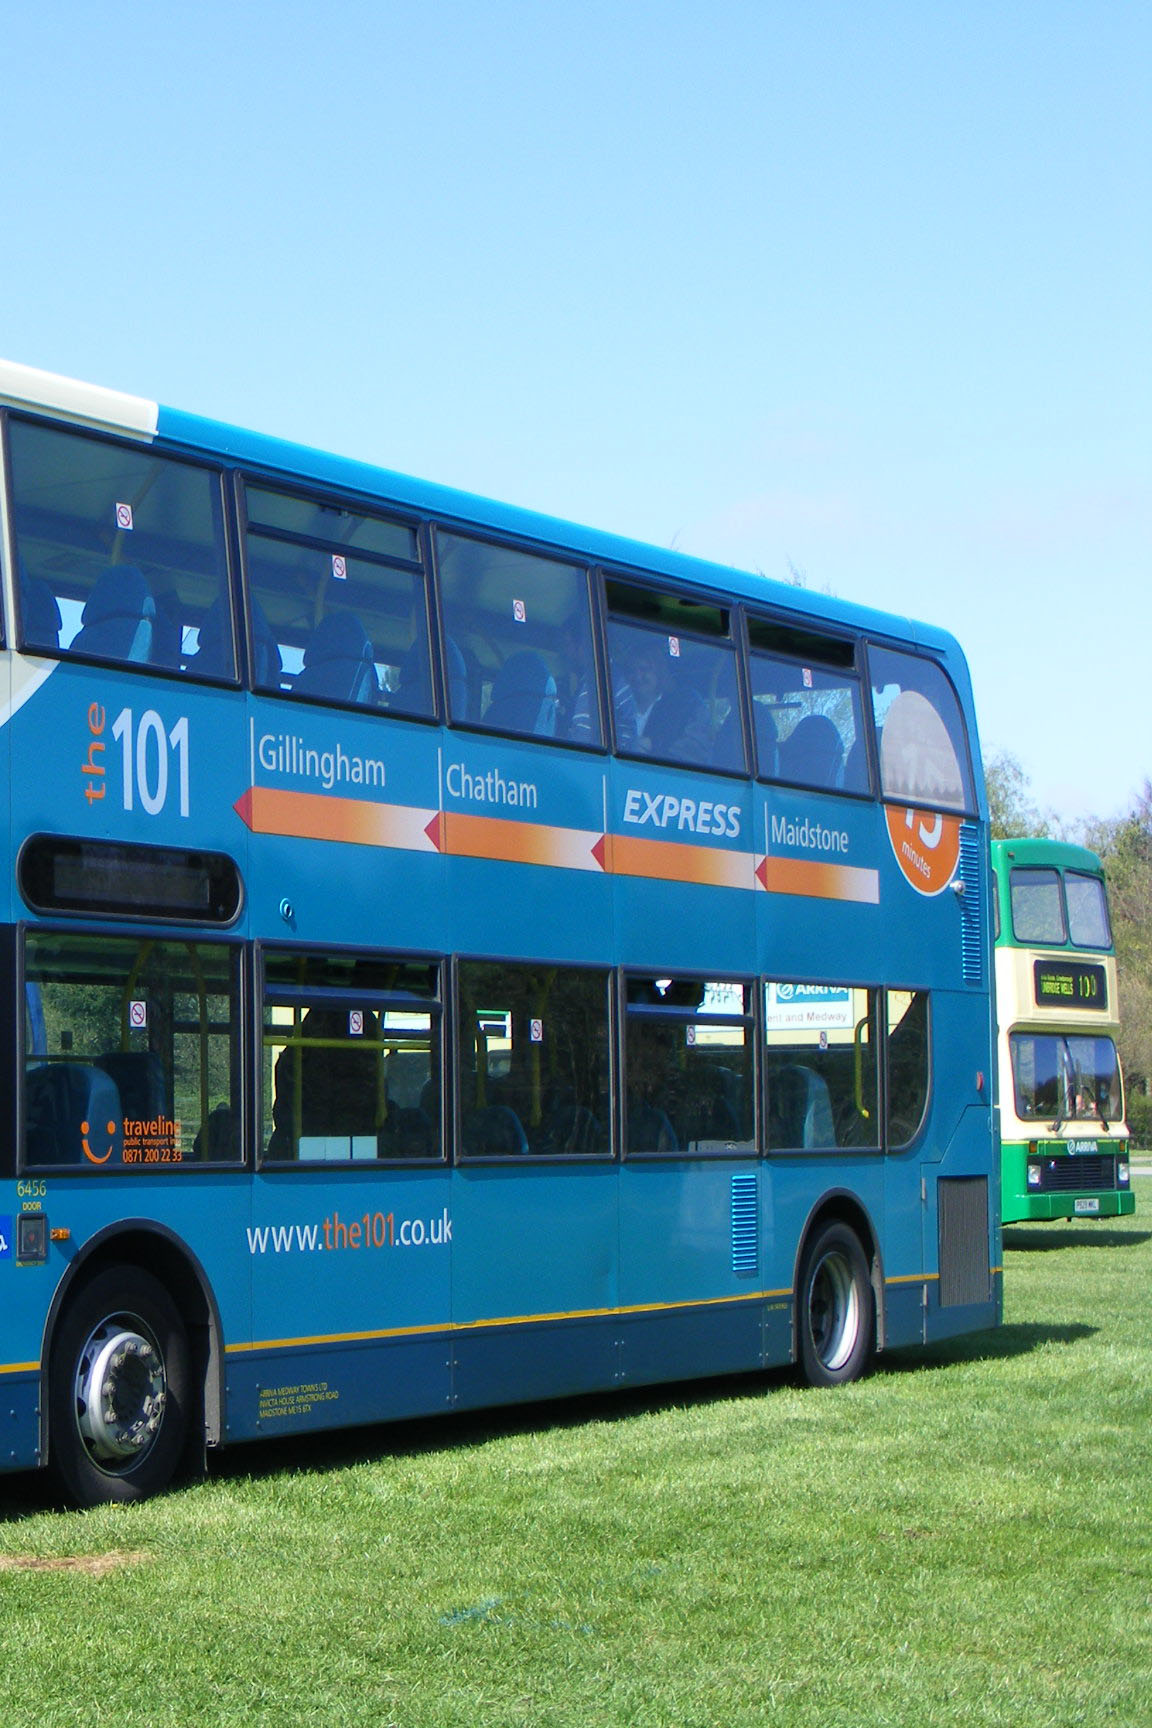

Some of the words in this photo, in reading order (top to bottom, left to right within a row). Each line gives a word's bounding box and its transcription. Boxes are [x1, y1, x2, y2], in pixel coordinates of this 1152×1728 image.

[81, 702, 106, 806] the
[111, 707, 190, 818] 101
[258, 734, 386, 789] Gillingham
[446, 763, 538, 809] Chatham
[623, 789, 742, 838] EXPRESS
[771, 815, 849, 853] Maidstone
[901, 840, 932, 880] minutes
[767, 1014, 783, 1023] ent
[785, 1013, 803, 1022] and
[806, 1012, 847, 1024] Medway
[123, 1115, 182, 1136] traveline
[123, 1137, 141, 1147] public
[143, 1137, 168, 1147] transport
[1075, 1141, 1098, 1152] ARRIVA
[123, 1149, 142, 1162] 0871
[144, 1148, 159, 1162] 200
[161, 1148, 171, 1162] 22
[172, 1148, 182, 1162] 33
[17, 1180, 47, 1197] 6456
[22, 1201, 42, 1211] DOOR
[246, 1207, 452, 1254] www.the101.co.uk
[278, 1385, 300, 1396] MEDWAY
[300, 1383, 318, 1394] TOWNS
[279, 1396, 295, 1406] HOUSE
[295, 1393, 325, 1404] ARMSTRONG
[326, 1390, 339, 1400] ROAD
[259, 1406, 288, 1418] MAIDSTONE
